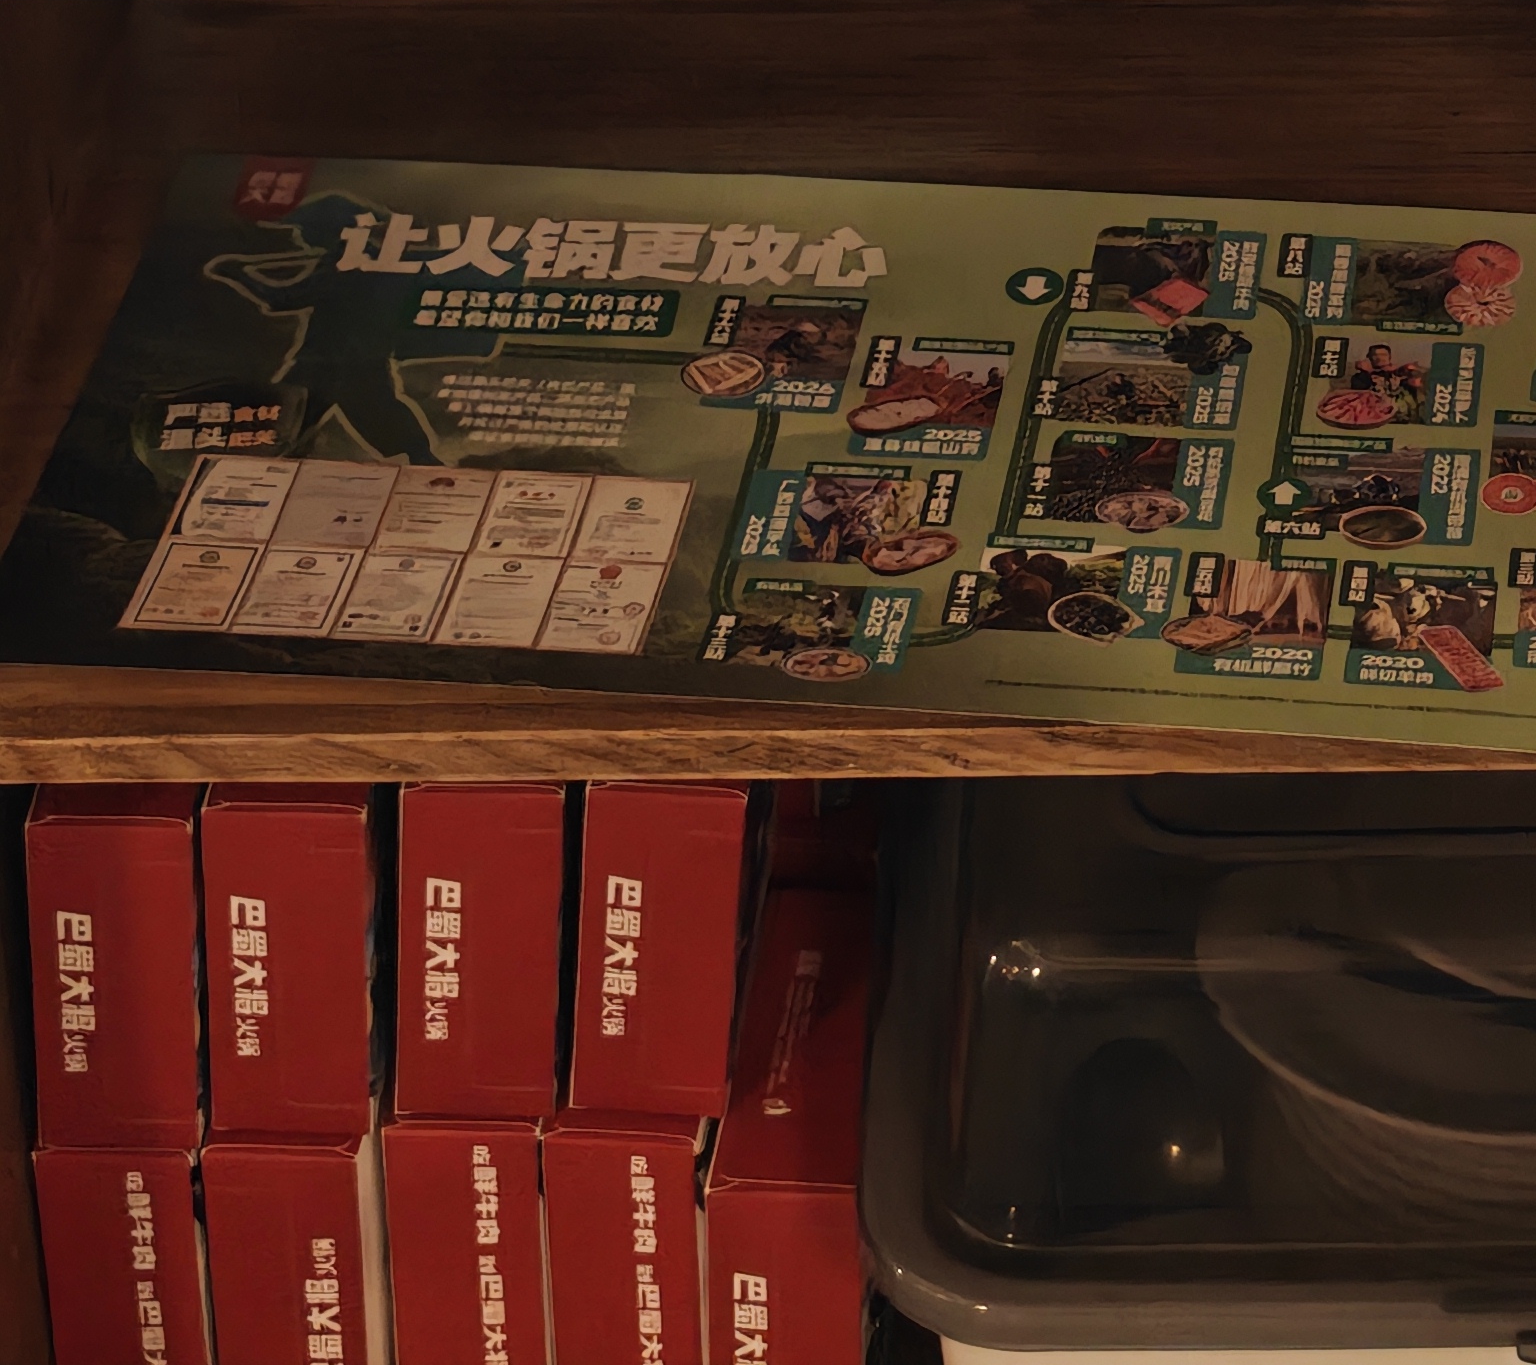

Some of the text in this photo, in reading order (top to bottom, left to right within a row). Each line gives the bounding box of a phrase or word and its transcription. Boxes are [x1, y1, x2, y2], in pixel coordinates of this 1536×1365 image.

[336, 211, 888, 288] 让火锅更放心
[1183, 444, 1206, 487] 2025
[1430, 452, 1452, 496] 2022
[1263, 519, 1322, 537] 第六站
[1126, 553, 1151, 595] 2025
[1251, 646, 1314, 661] 2020
[1359, 654, 1425, 669] 2020
[733, 1271, 769, 1365] 巴蜀大
